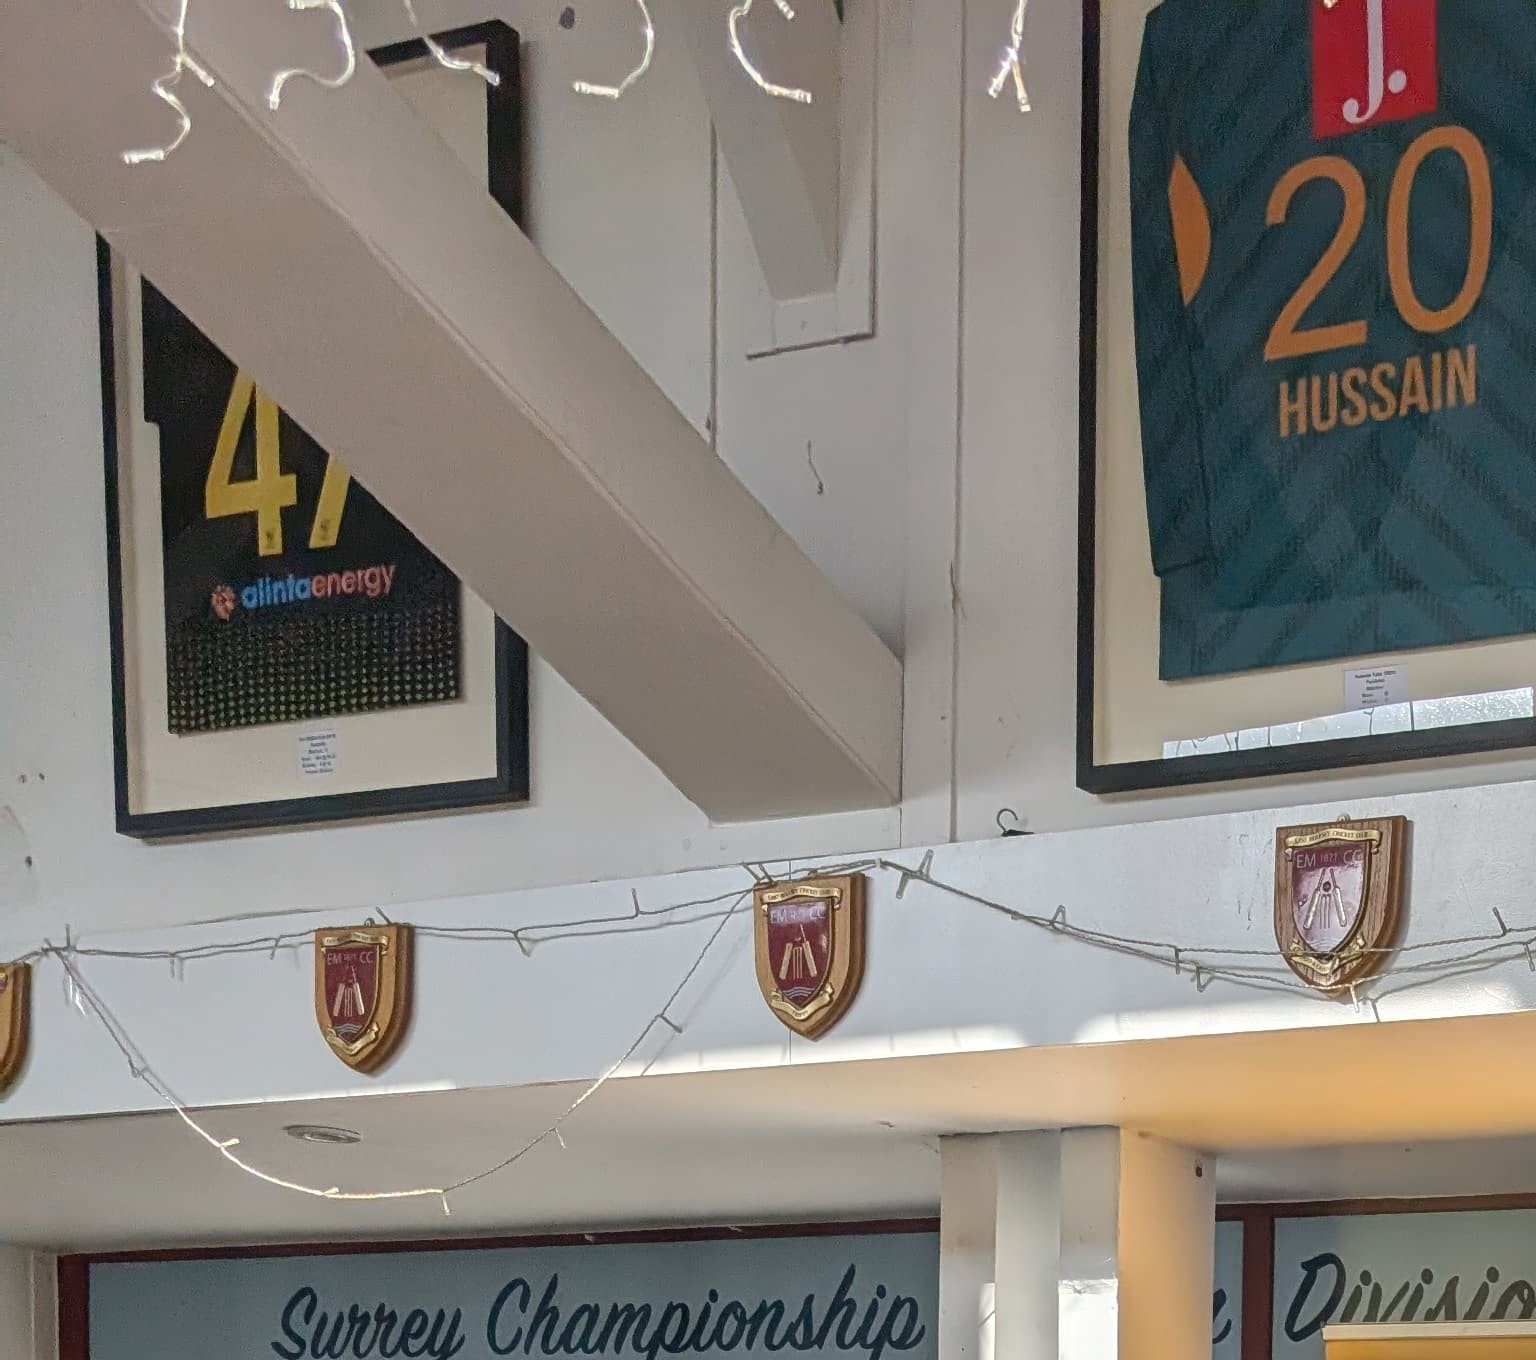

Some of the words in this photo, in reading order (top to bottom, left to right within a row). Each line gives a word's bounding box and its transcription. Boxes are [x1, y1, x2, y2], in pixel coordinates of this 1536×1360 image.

[1263, 124, 1494, 362] 20
[1279, 343, 1478, 438] HUSSAIN
[241, 564, 396, 609] alintaenergy
[1296, 853, 1316, 869] EM
